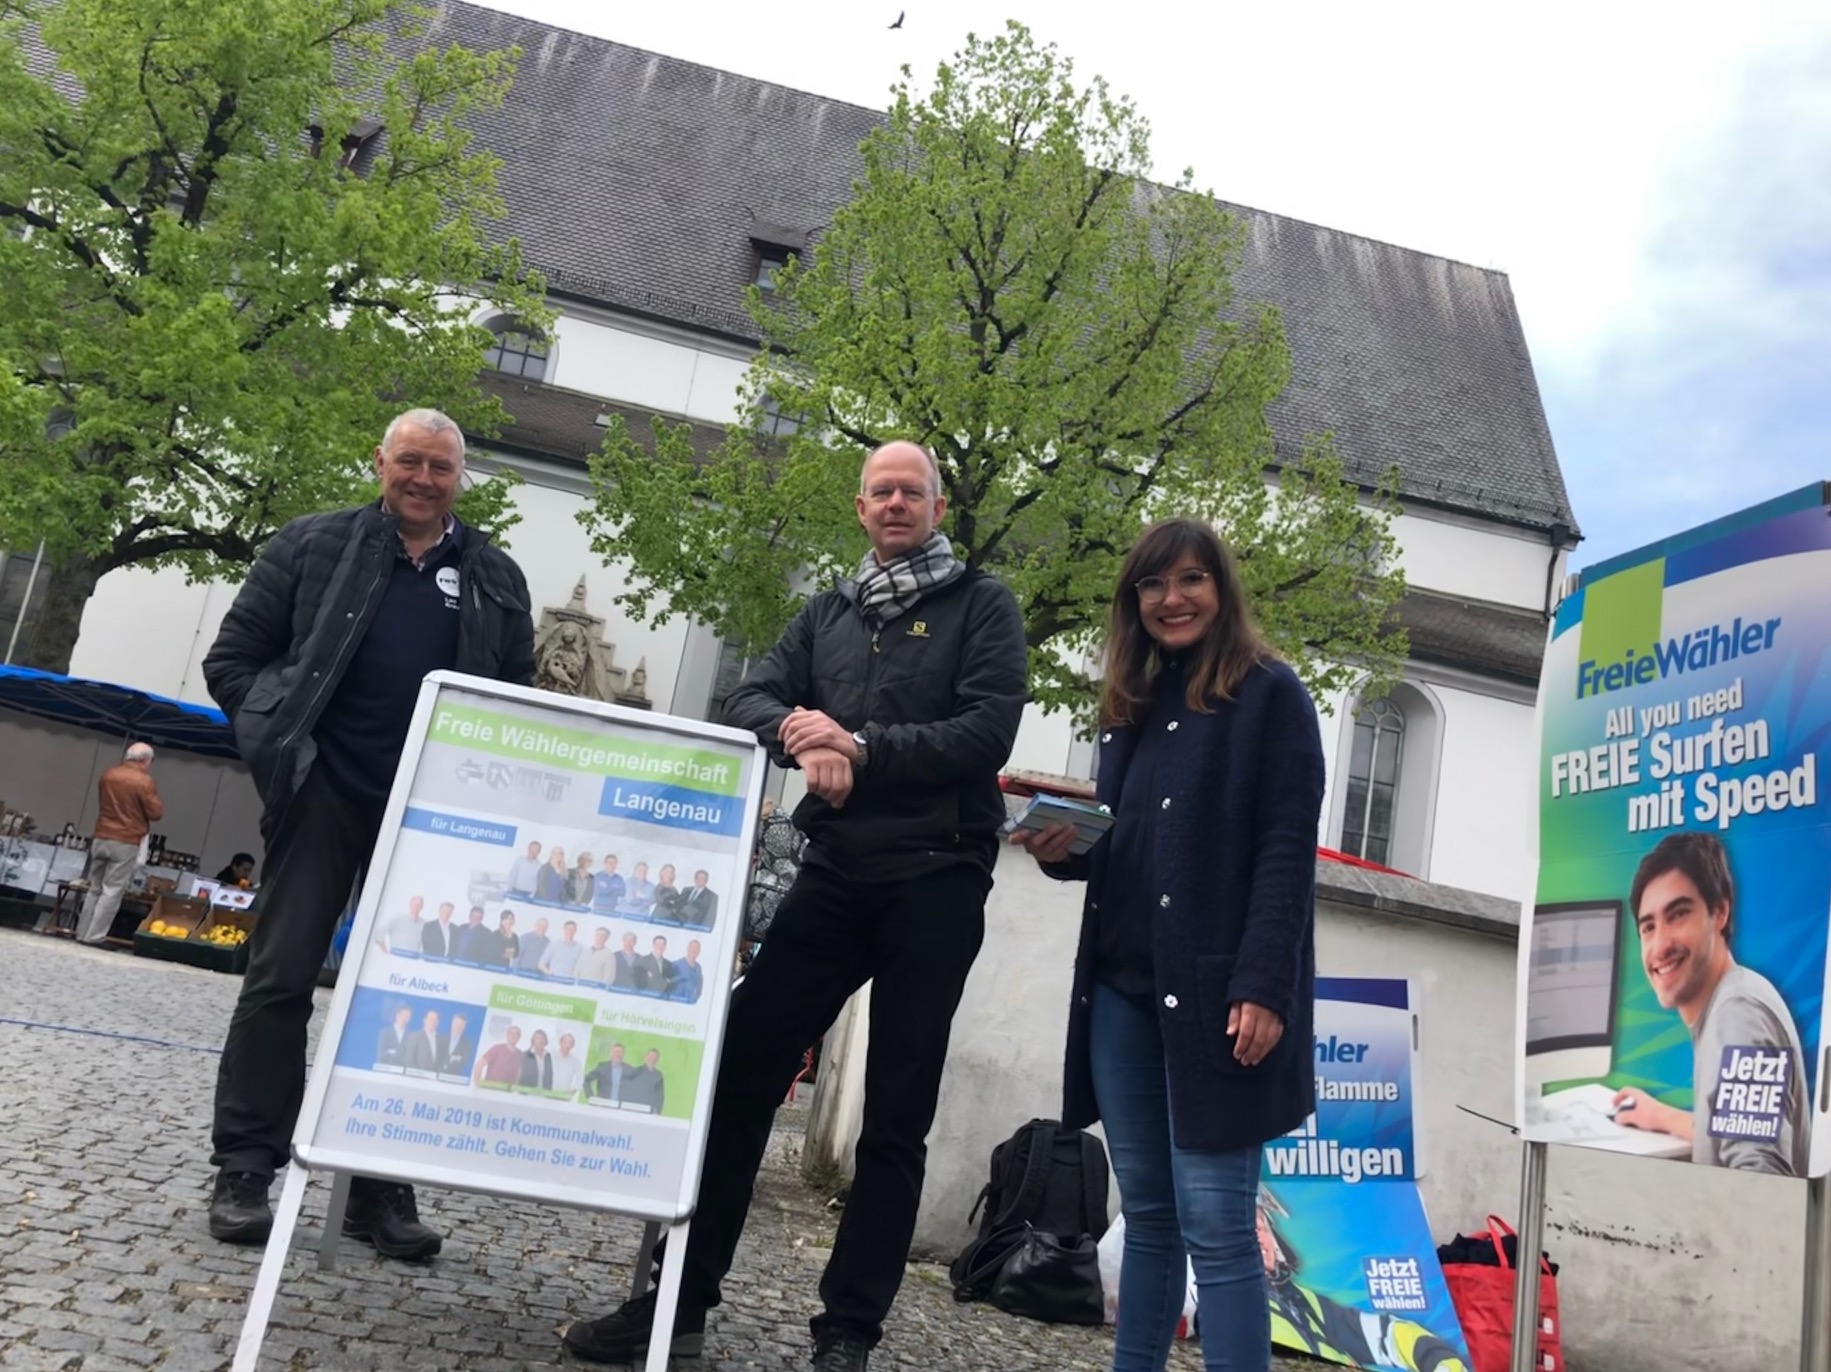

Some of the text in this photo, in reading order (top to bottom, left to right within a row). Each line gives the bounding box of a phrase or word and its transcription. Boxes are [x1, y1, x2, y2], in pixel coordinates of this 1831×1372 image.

[1577, 617, 1781, 700] FreieWähler
[1605, 677, 1743, 739] All you need
[434, 711, 729, 786] Freie Wählergemeinschaft
[1551, 718, 1769, 798] FREIE Surfen
[613, 787, 721, 824] Langenau
[1628, 753, 1816, 832] mit Speed
[430, 817, 507, 842] für Langenau
[389, 973, 449, 993] für Albeck
[497, 991, 574, 1014] für Göttingen
[1313, 1035, 1369, 1063] hler
[1721, 1049, 1788, 1082] Jetzt
[1715, 1082, 1783, 1114] FREIE
[351, 1093, 635, 1152] Am 26. Mai 2019 ist Kommunalwahl.
[1711, 1112, 1778, 1137] wählen!
[345, 1117, 652, 1179] Ihre Stimme zählt. Gehen Sie zur Wahl.
[1264, 1139, 1404, 1184] willigen
[1366, 1258, 1418, 1278] Jetzt
[1369, 1278, 1423, 1296] FREIE
[1372, 1295, 1426, 1310] wählen!
